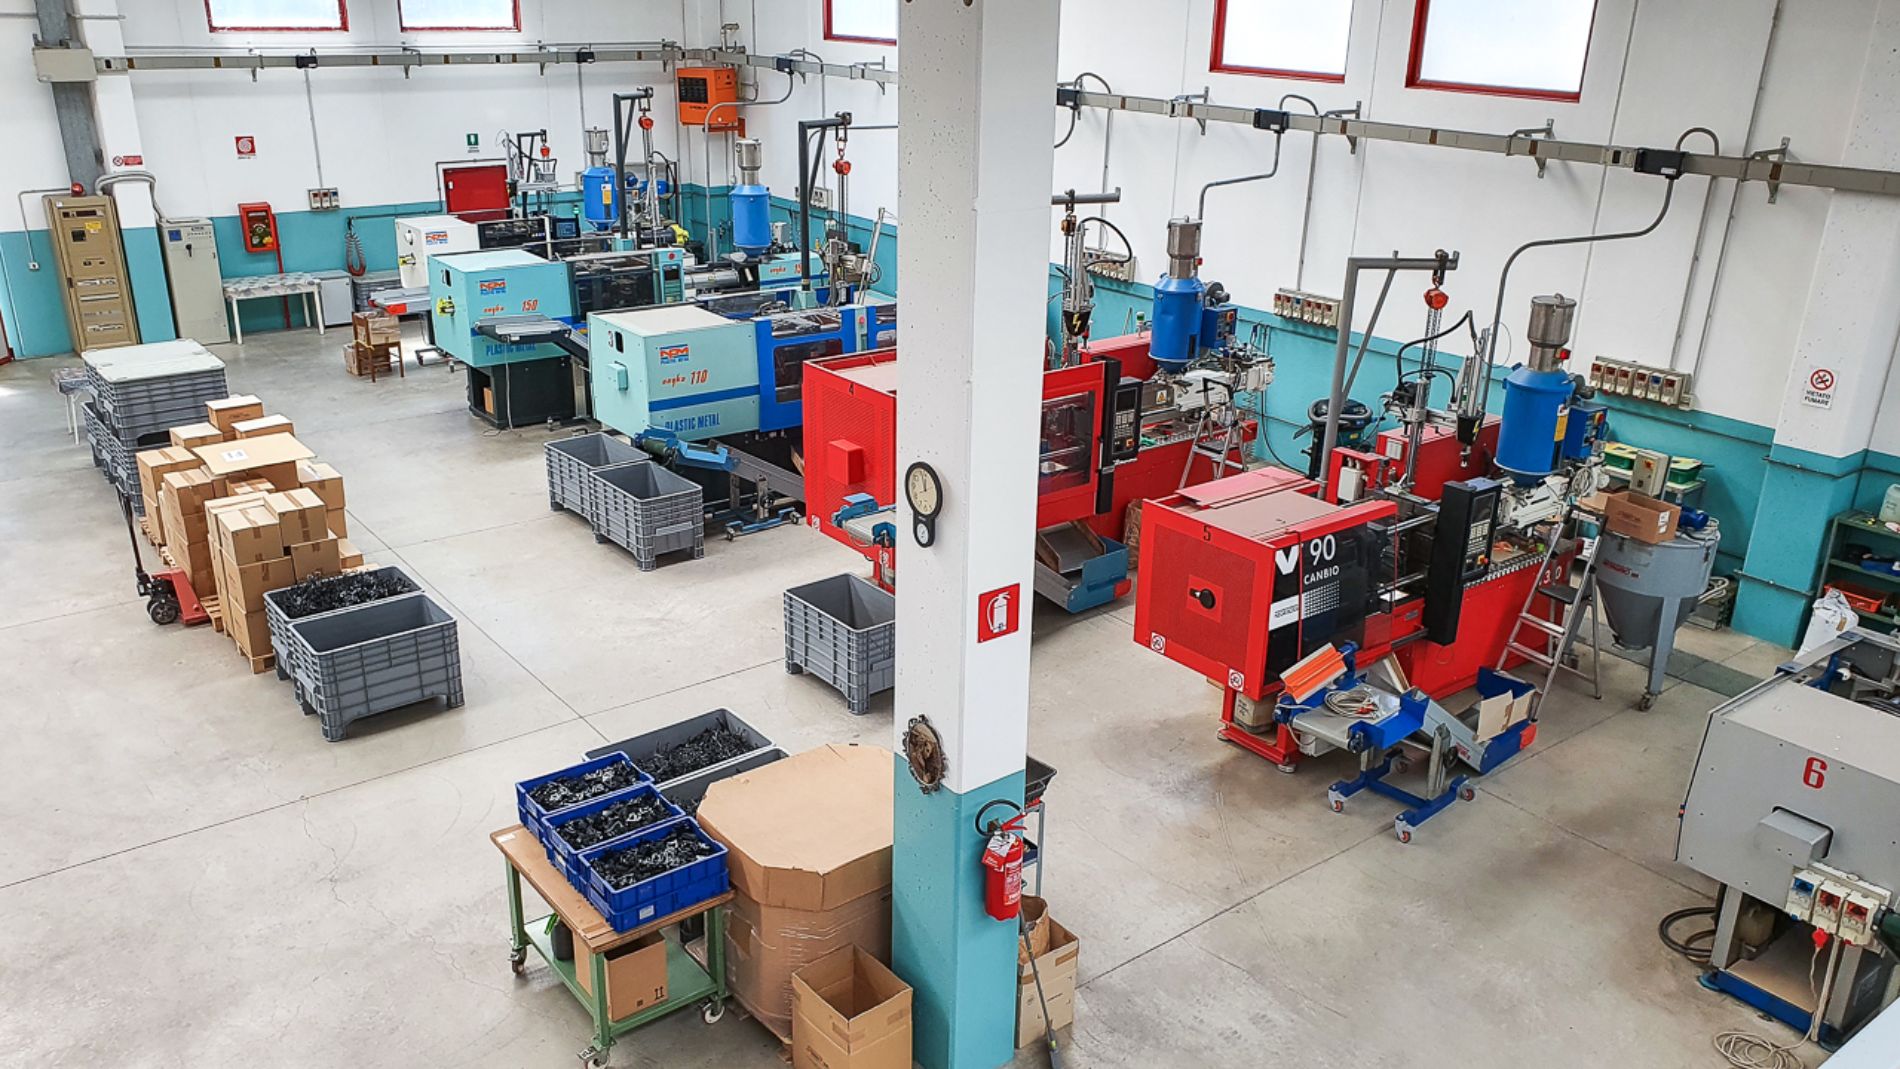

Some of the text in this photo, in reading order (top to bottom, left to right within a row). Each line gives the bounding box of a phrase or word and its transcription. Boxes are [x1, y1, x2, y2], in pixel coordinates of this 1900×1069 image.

[522, 299, 538, 312] 150
[690, 369, 708, 385] 110
[698, 412, 720, 428] METAL
[1203, 525, 1212, 541] 5
[1309, 534, 1336, 566] 90
[1304, 565, 1340, 585] CANBIO
[1803, 756, 1828, 789] 6
